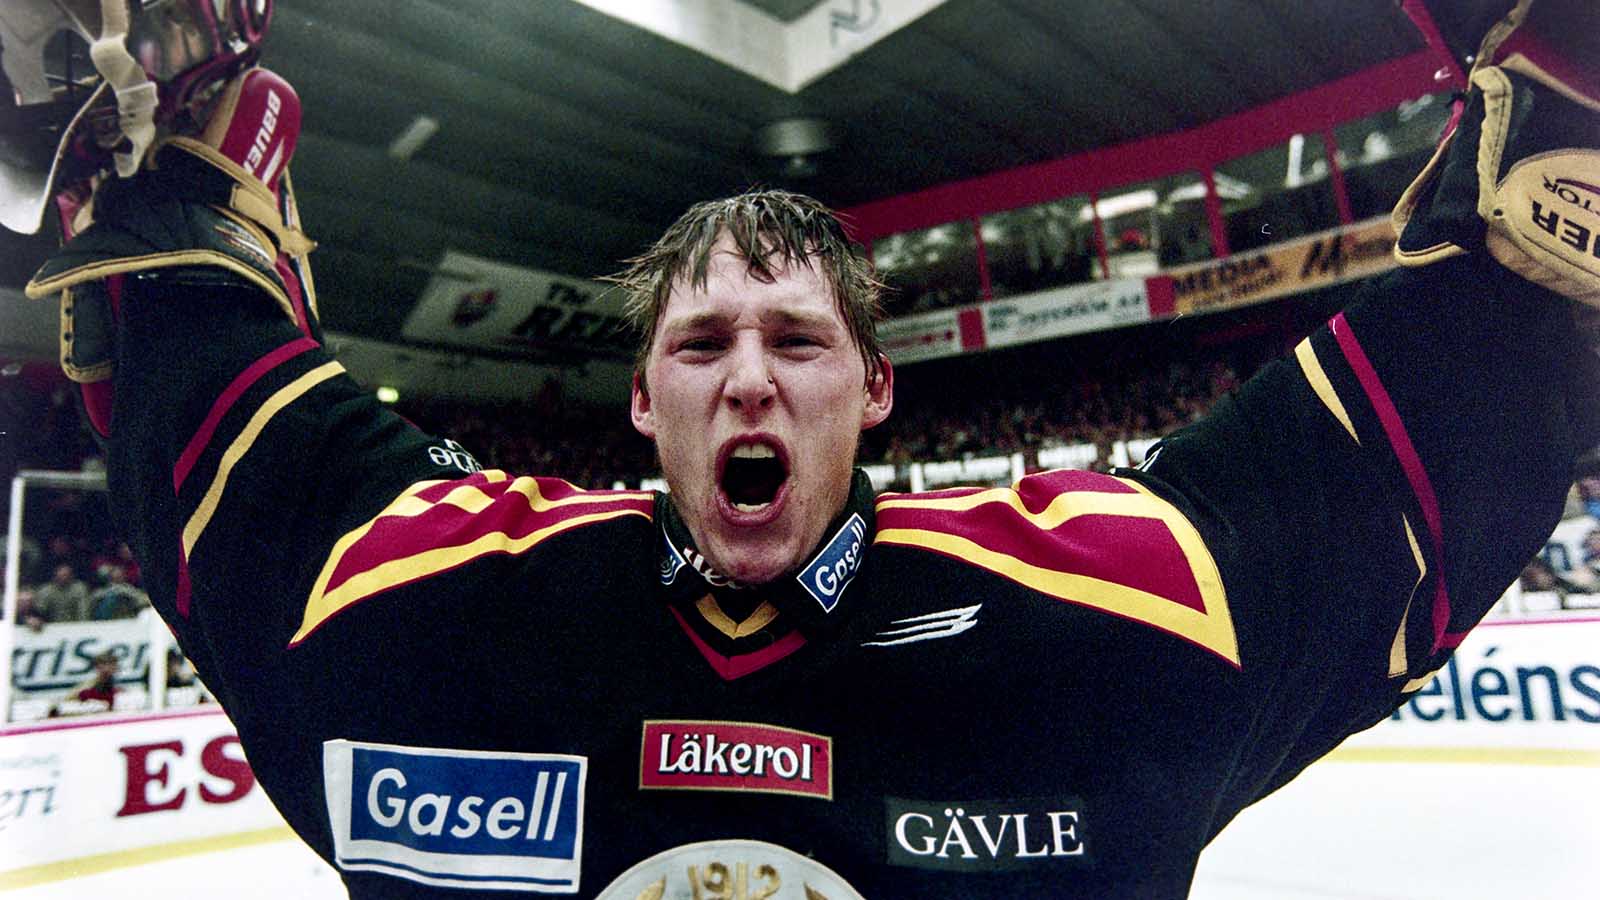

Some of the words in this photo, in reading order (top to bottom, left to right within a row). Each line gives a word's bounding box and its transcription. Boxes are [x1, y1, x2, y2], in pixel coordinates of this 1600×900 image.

[1543, 175, 1599, 215] TOR
[1392, 643, 1600, 724] eléns
[658, 733, 813, 781] Läkerol
[366, 767, 568, 842] Gasell
[895, 807, 1085, 859] GÄVLE
[686, 861, 782, 900] 1912
